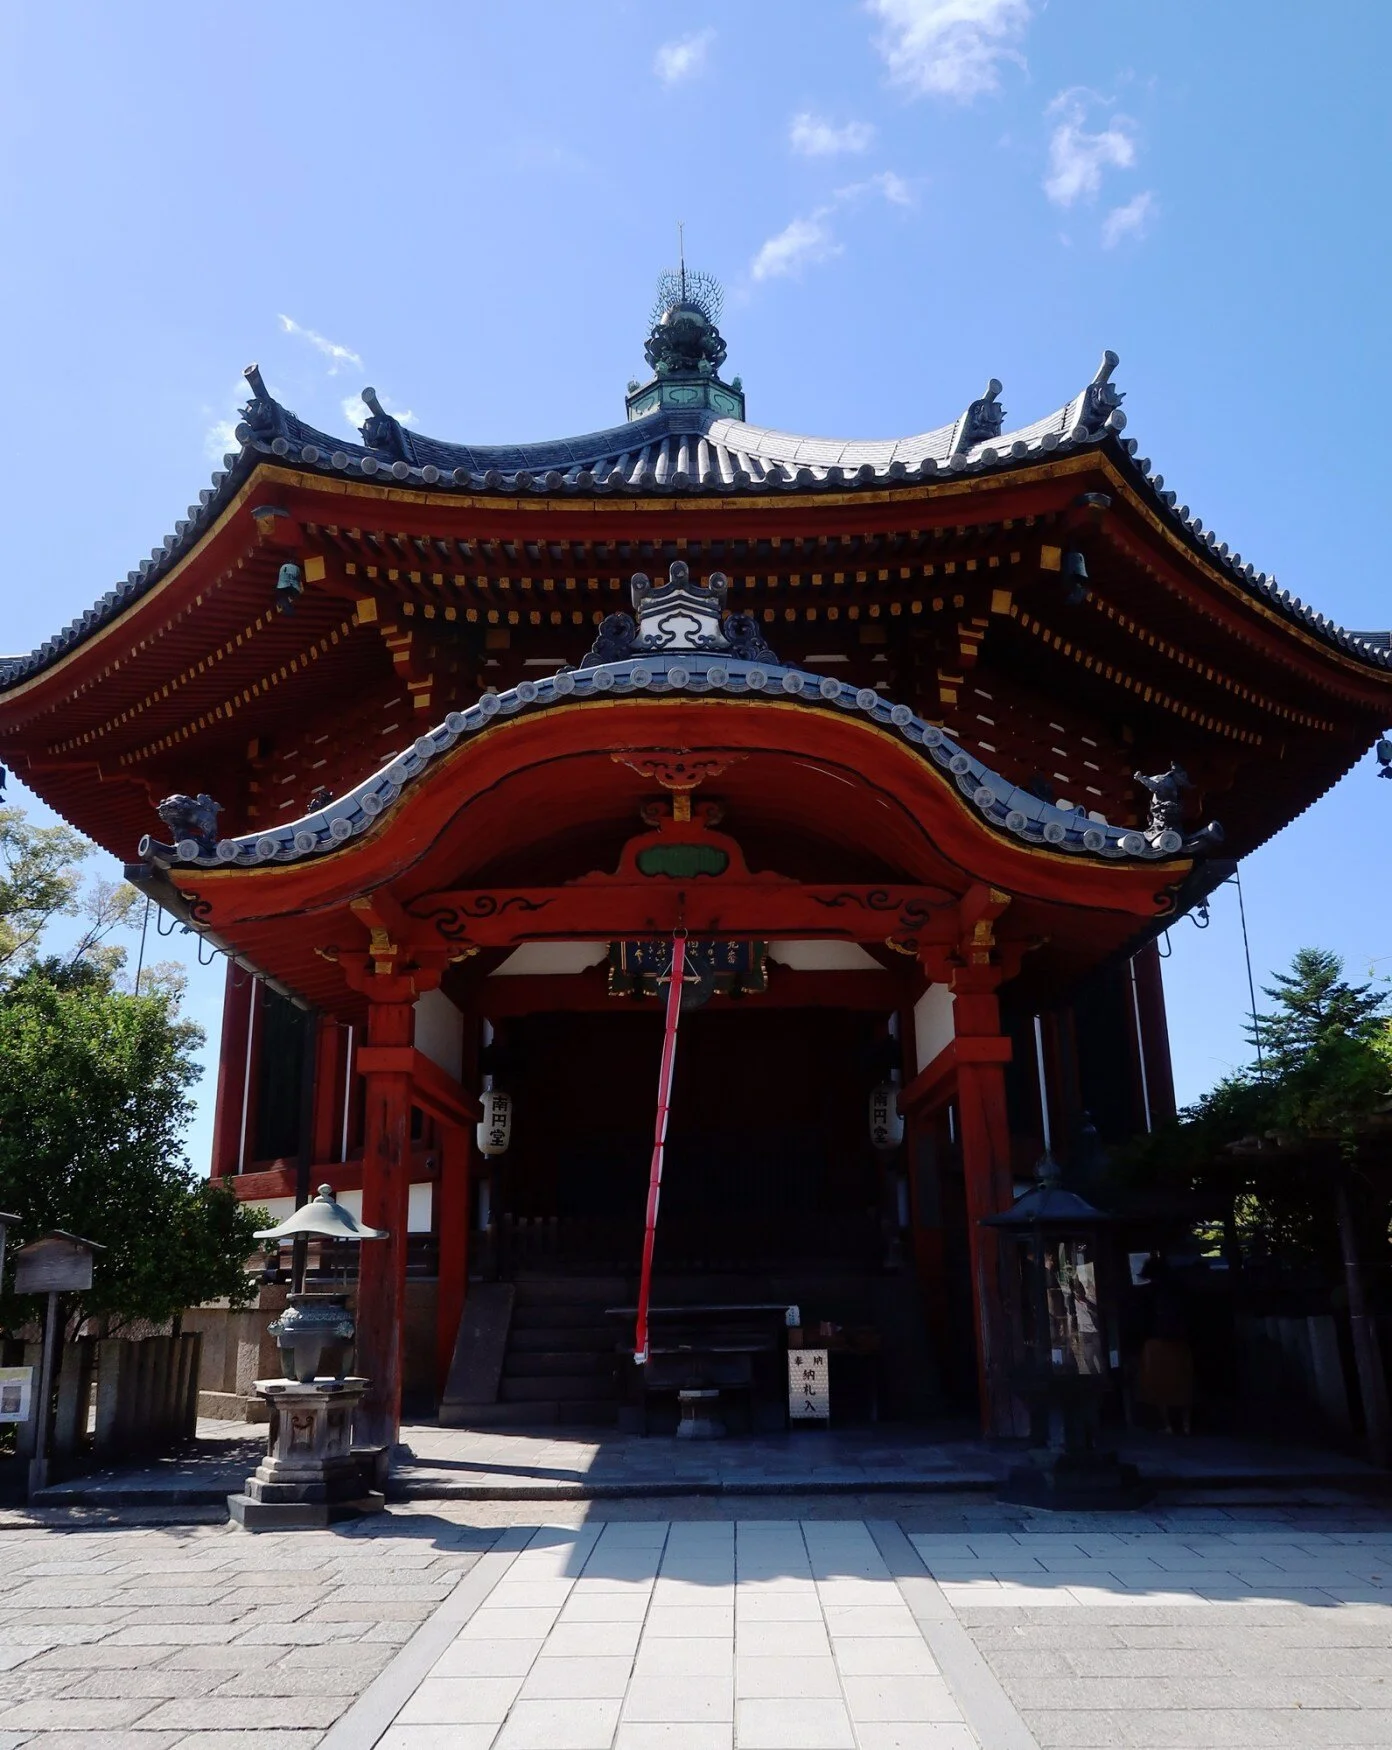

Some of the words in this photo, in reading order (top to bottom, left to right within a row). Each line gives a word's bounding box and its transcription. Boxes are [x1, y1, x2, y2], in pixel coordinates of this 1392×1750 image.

[489, 1095, 508, 1147] 南円堂
[873, 1090, 888, 1144] 南円堂
[794, 1356, 823, 1367] 奉納
[802, 1369, 816, 1412] 納札入
